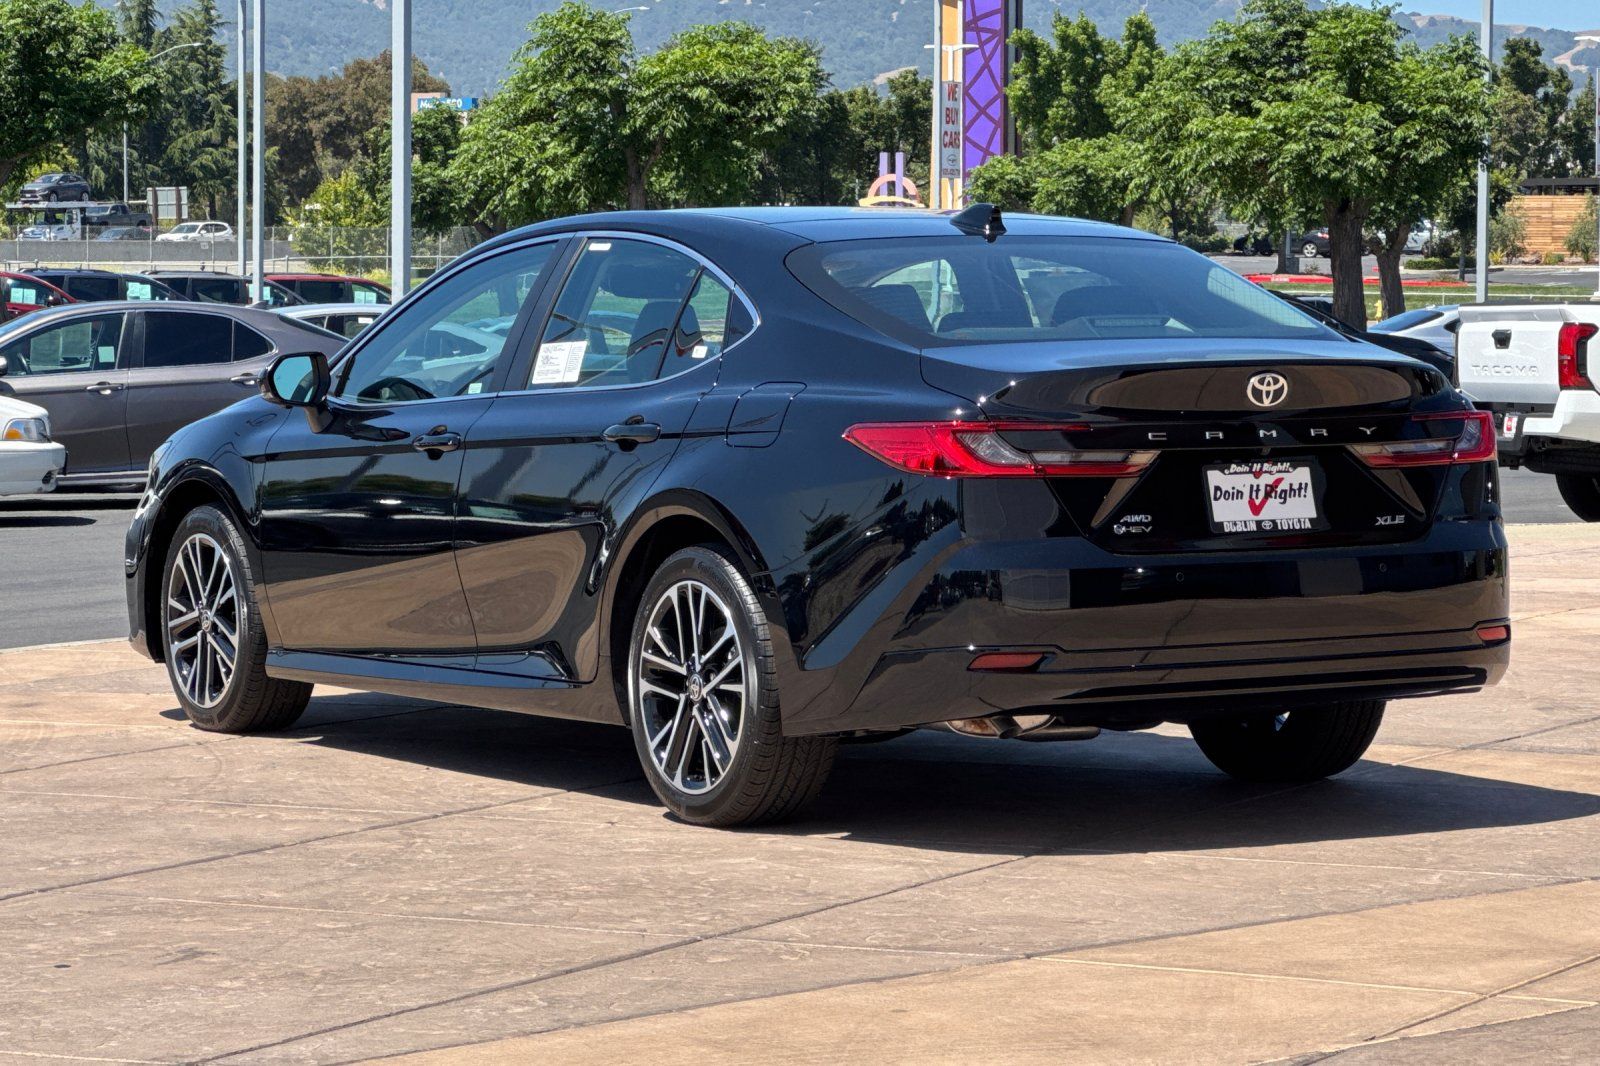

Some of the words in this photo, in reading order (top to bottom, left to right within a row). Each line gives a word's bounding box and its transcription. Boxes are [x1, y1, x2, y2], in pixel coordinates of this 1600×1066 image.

[947, 83, 958, 101] WE
[945, 107, 959, 125] BUY
[943, 131, 961, 149] CARS
[1471, 365, 1540, 377] TACOMA
[1148, 426, 1377, 441] CAMRY
[1229, 463, 1252, 473] Doin'
[1252, 463, 1262, 472] It
[1262, 462, 1290, 475] Right!
[1213, 484, 1246, 501] Doin'
[1249, 483, 1261, 500] It
[1264, 482, 1309, 505] Right!
[1120, 514, 1152, 522] AWD
[1223, 520, 1257, 532] DUBLIN
[1275, 518, 1312, 530] TOYOTA
[1375, 514, 1405, 525] XLE
